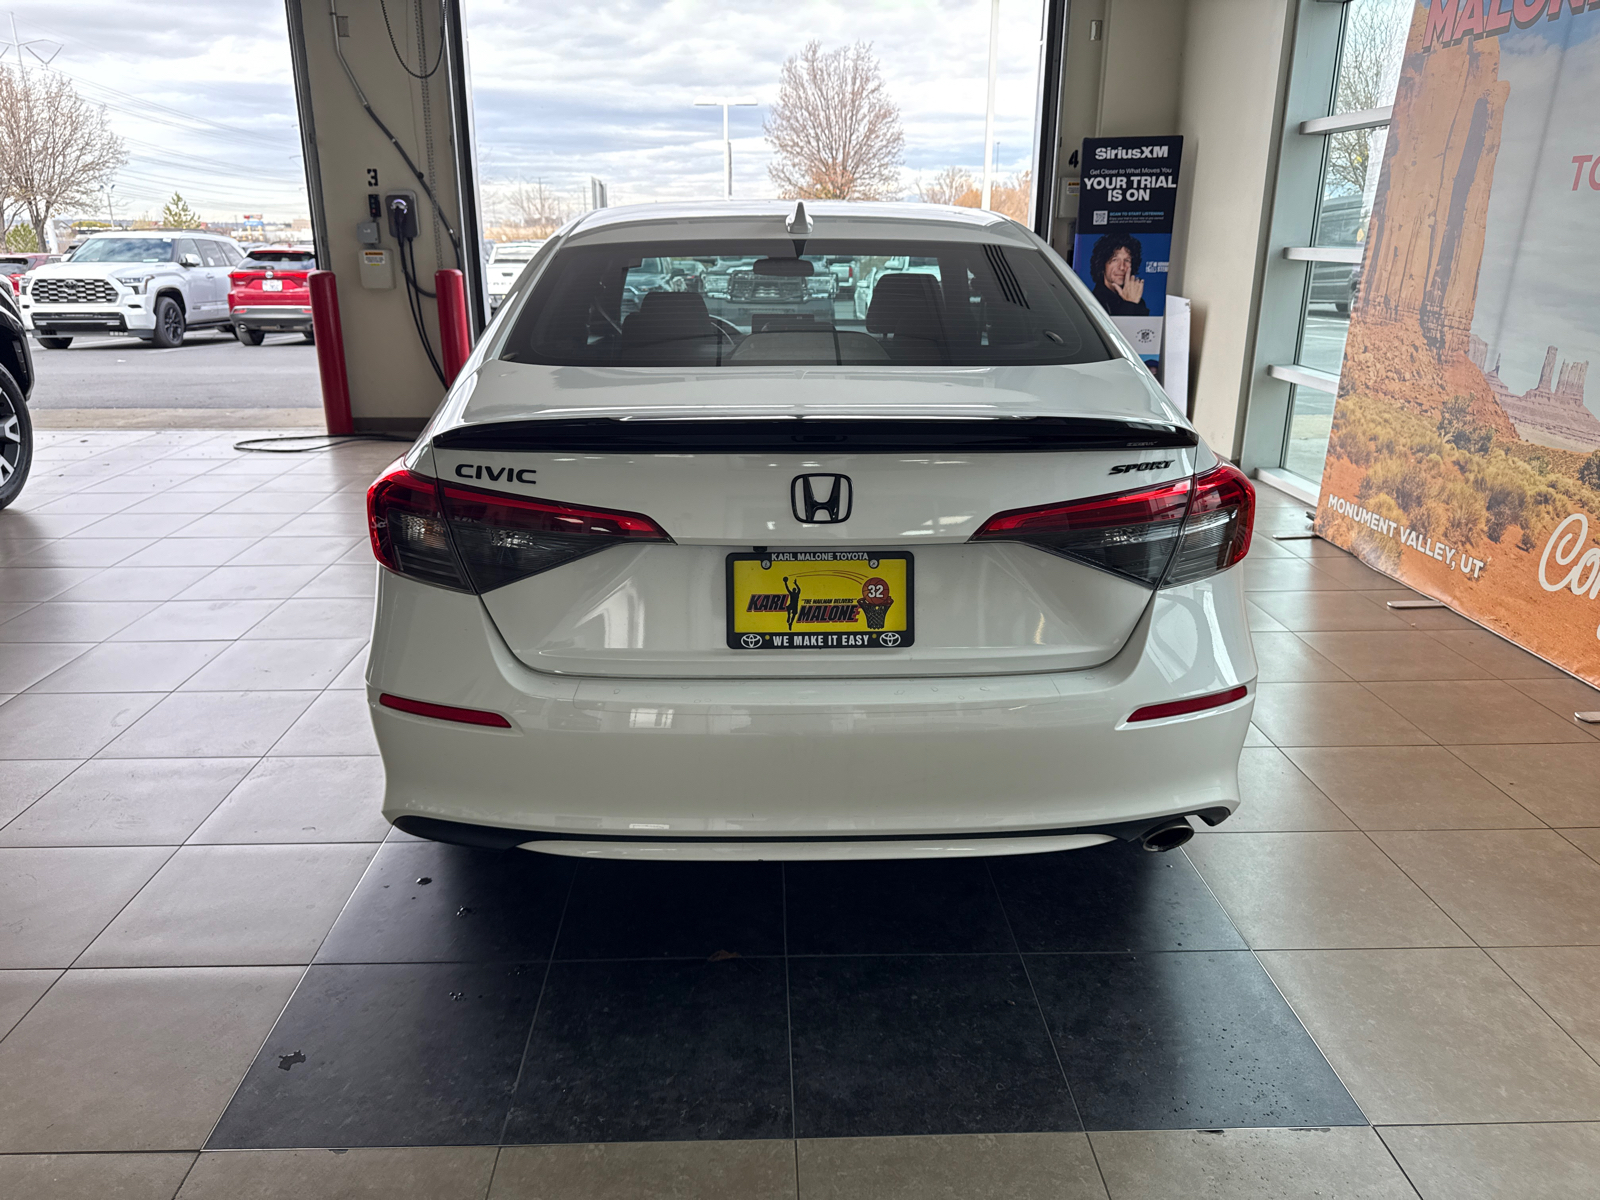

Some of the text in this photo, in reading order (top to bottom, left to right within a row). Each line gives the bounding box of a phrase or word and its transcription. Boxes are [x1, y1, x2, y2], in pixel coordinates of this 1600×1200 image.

[1422, 0, 1600, 53] MAL
[1068, 149, 1079, 169] 4
[1095, 145, 1169, 160] SiriusXM
[367, 168, 379, 187] 3
[1083, 176, 1127, 190] YOUR
[1130, 175, 1177, 189] TRIAL
[1107, 188, 1150, 202] IS ON
[455, 463, 537, 485] CIVIC
[1108, 459, 1175, 475] SPORT
[1327, 493, 1484, 579] MONUMENT VALLEY, UT
[771, 552, 869, 561] KARL MALONE TOYOTA
[867, 584, 884, 598] 32
[747, 593, 790, 612] KARL
[796, 604, 861, 623] MALONE
[772, 634, 869, 646] WE MAKE IT EASY
